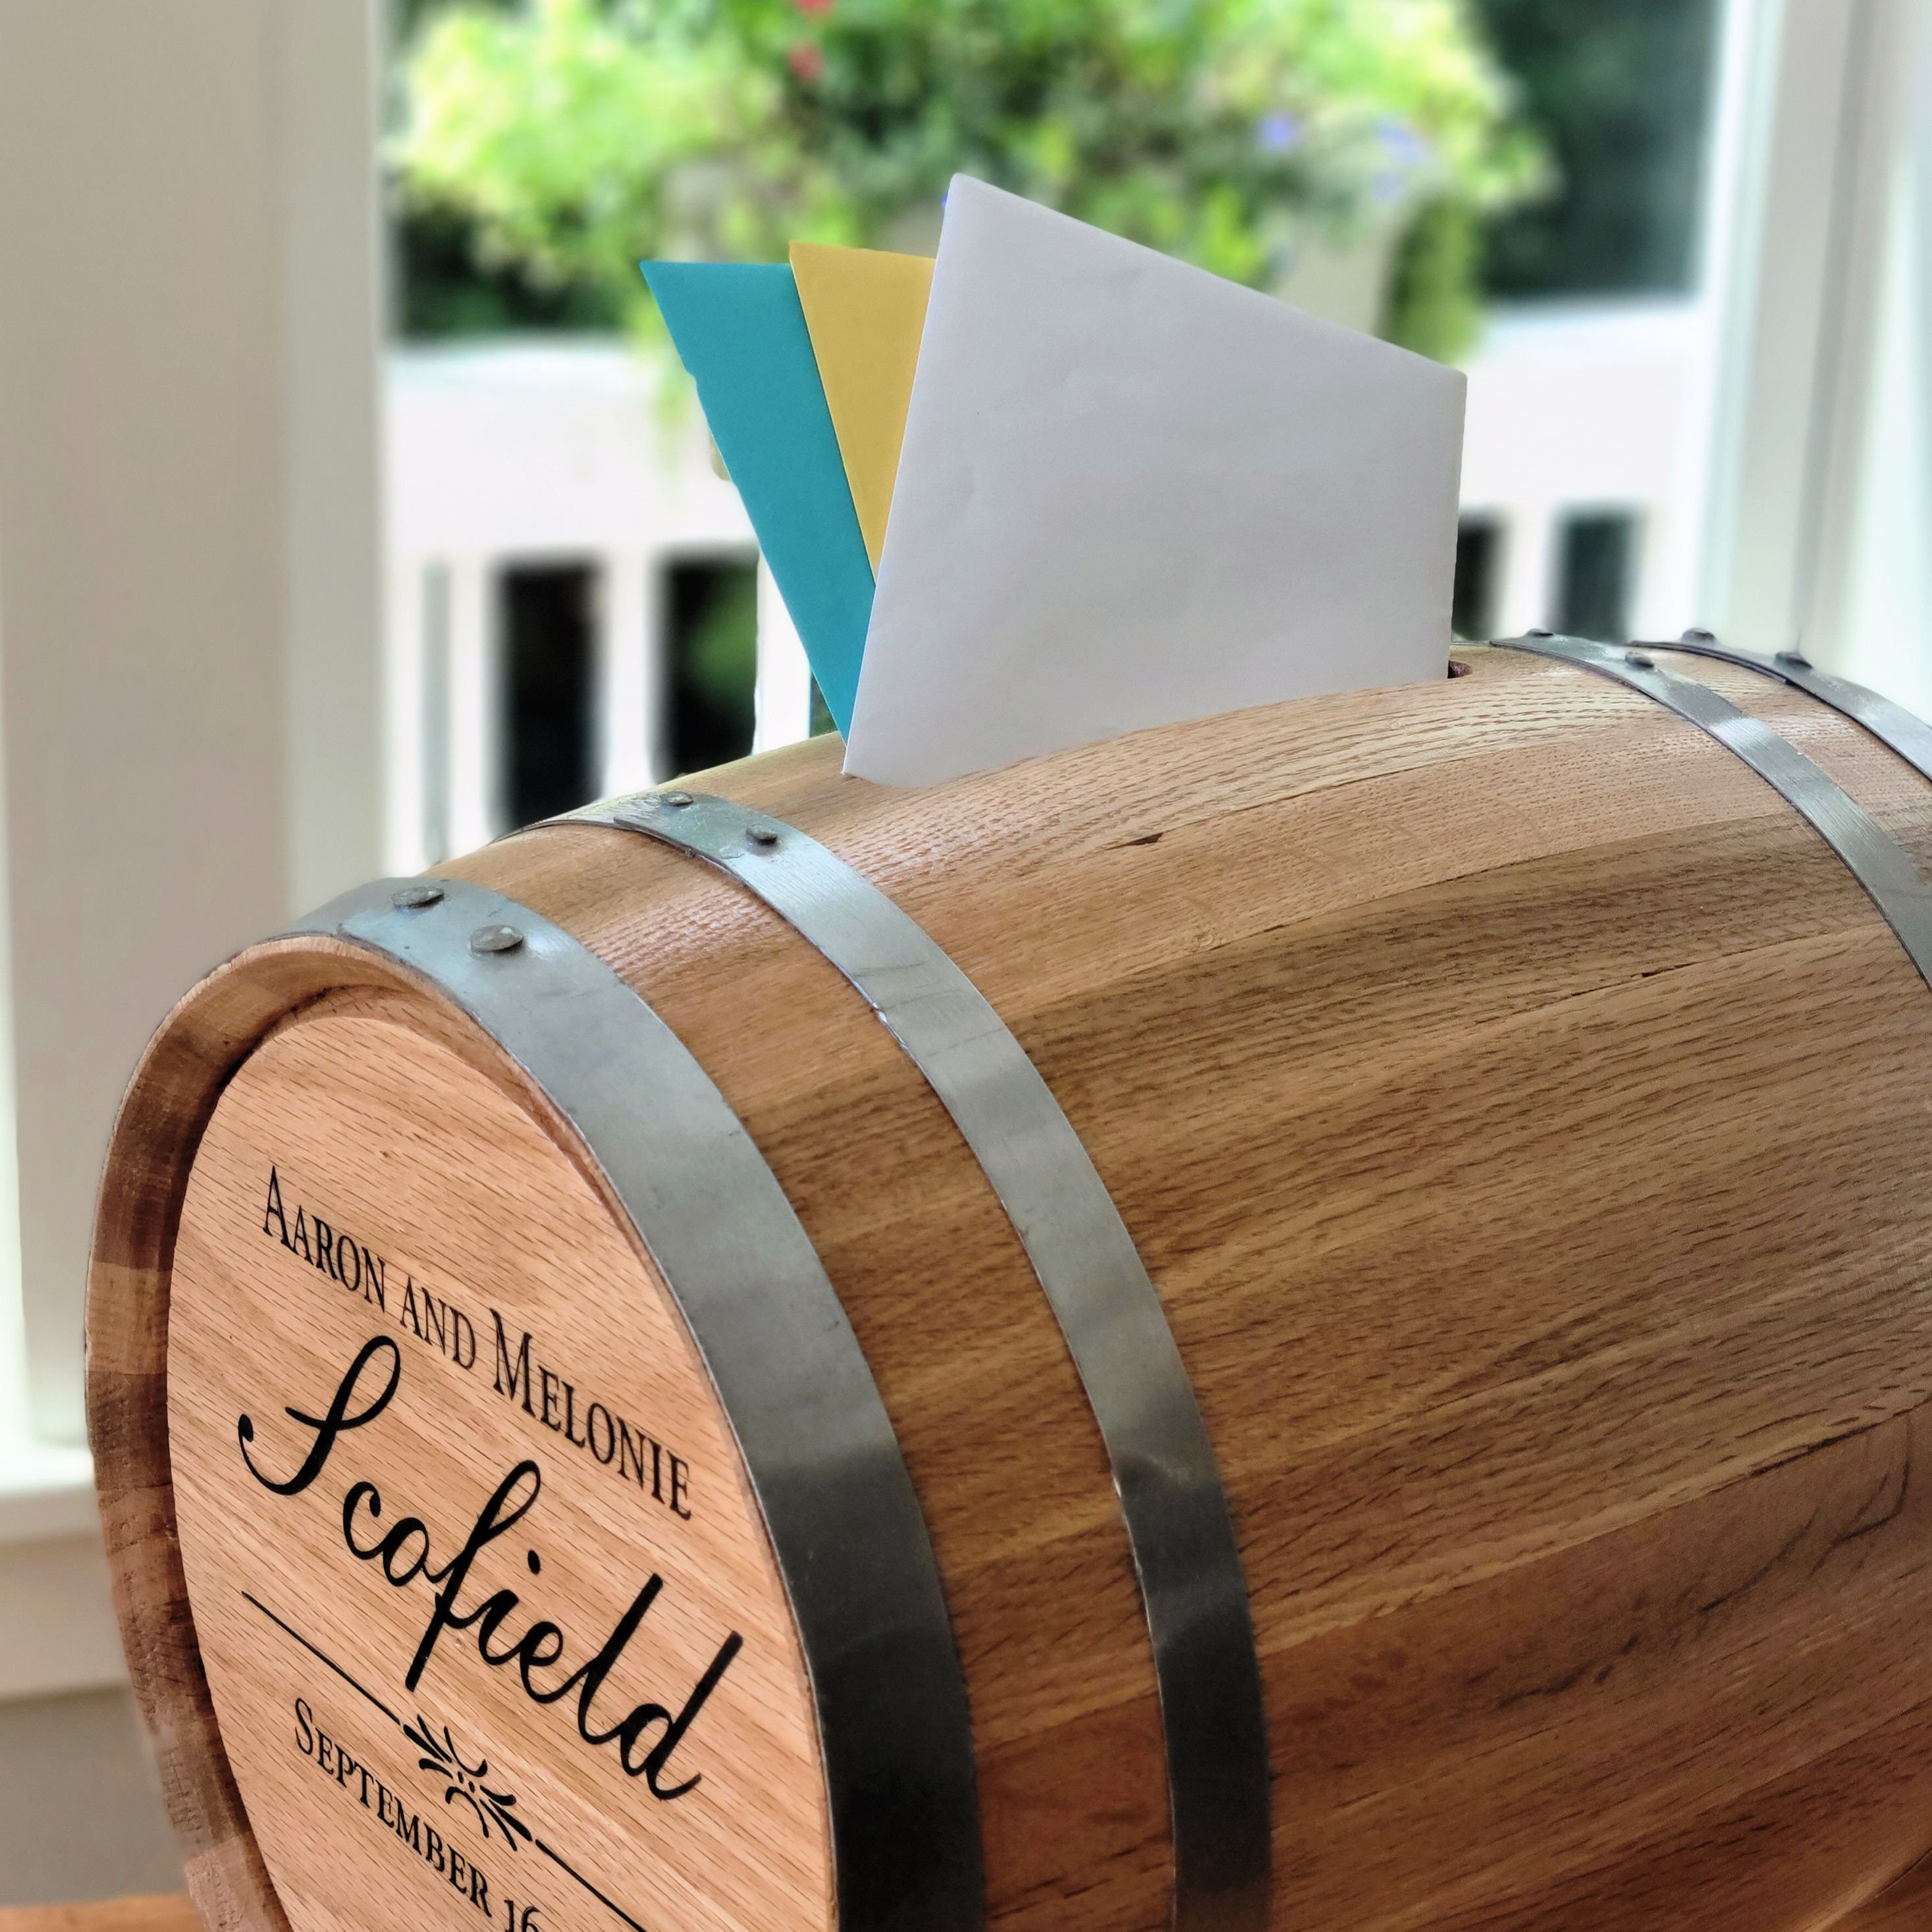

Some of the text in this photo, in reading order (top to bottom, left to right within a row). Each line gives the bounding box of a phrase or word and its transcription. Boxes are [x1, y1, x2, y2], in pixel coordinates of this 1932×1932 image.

[262, 1165, 692, 1521] AARON AND MELONIE
[237, 1335, 743, 1800] Scofield
[294, 1698, 492, 1918] SEPTEMBER
